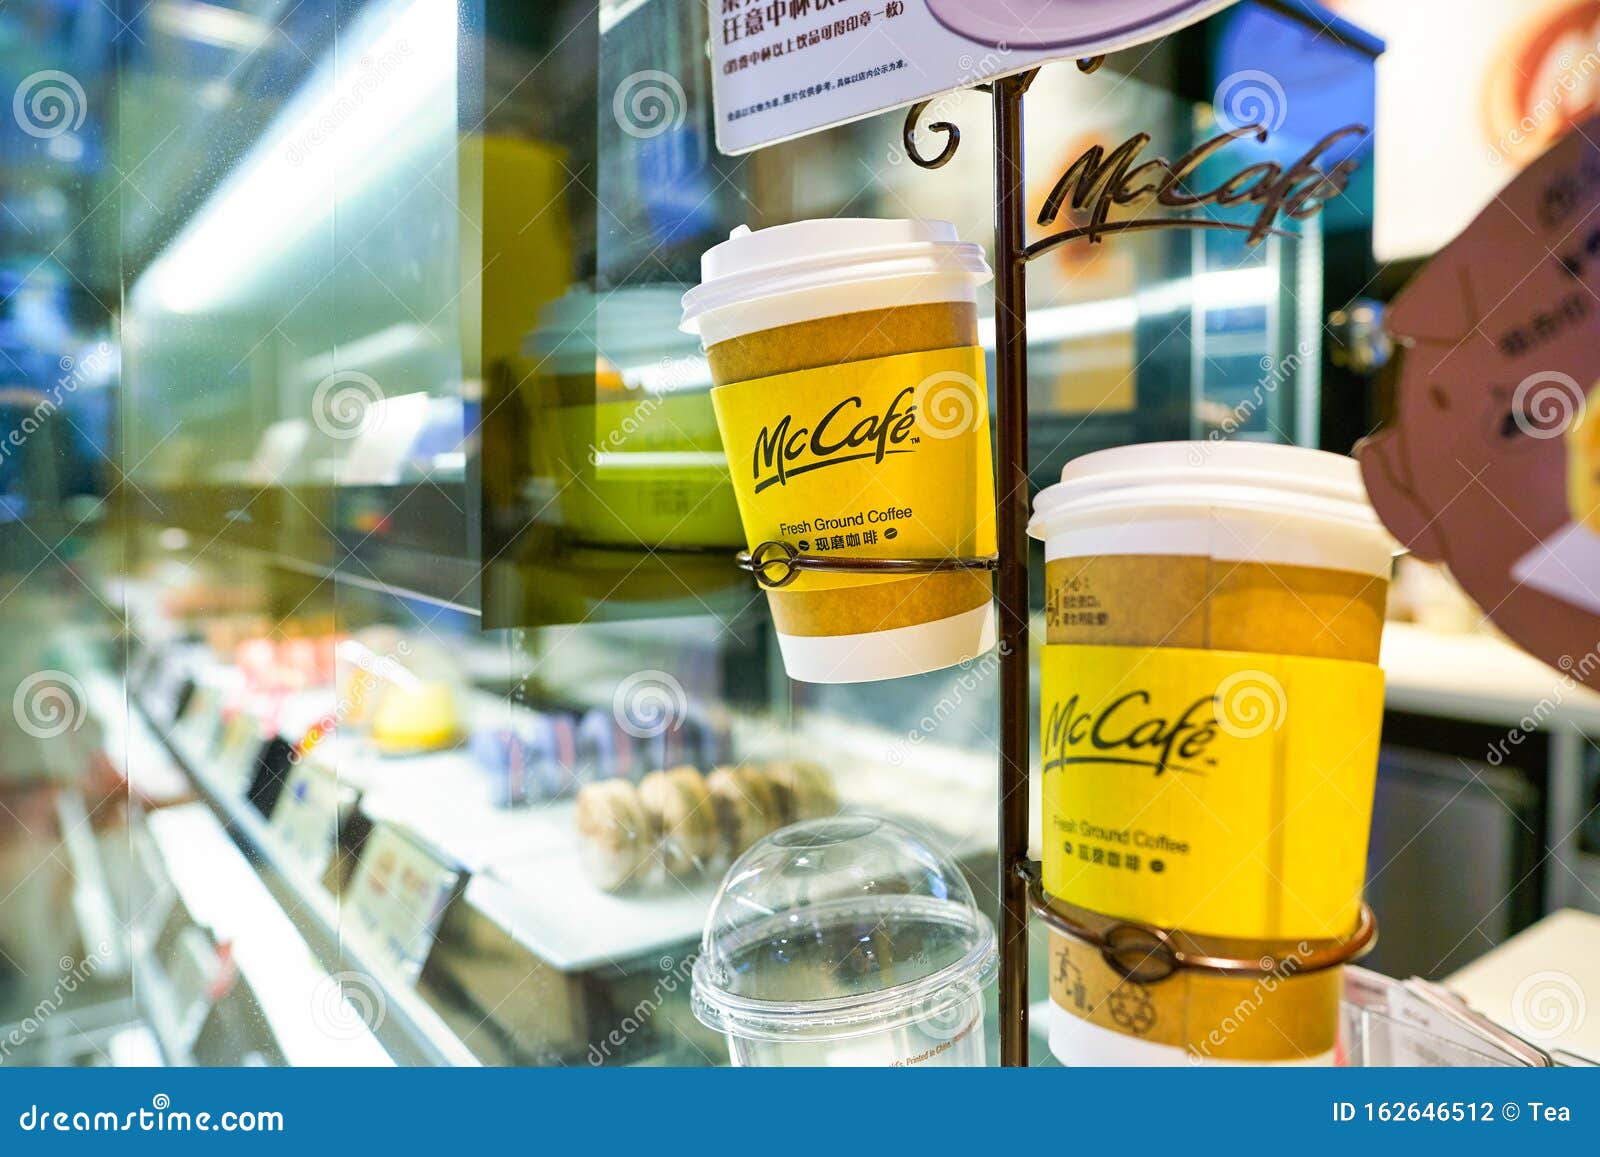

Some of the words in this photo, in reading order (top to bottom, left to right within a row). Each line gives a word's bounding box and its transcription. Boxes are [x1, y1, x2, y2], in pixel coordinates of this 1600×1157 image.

[723, 0, 847, 45] 任意中杯
[753, 387, 917, 488] McCafé
[780, 521, 811, 536] Fresh
[814, 513, 864, 531] Ground
[867, 506, 913, 523] Coffee
[815, 530, 878, 551] 现磨咖啡
[1045, 690, 1220, 777] McCafé
[1080, 820, 1130, 845] Ground
